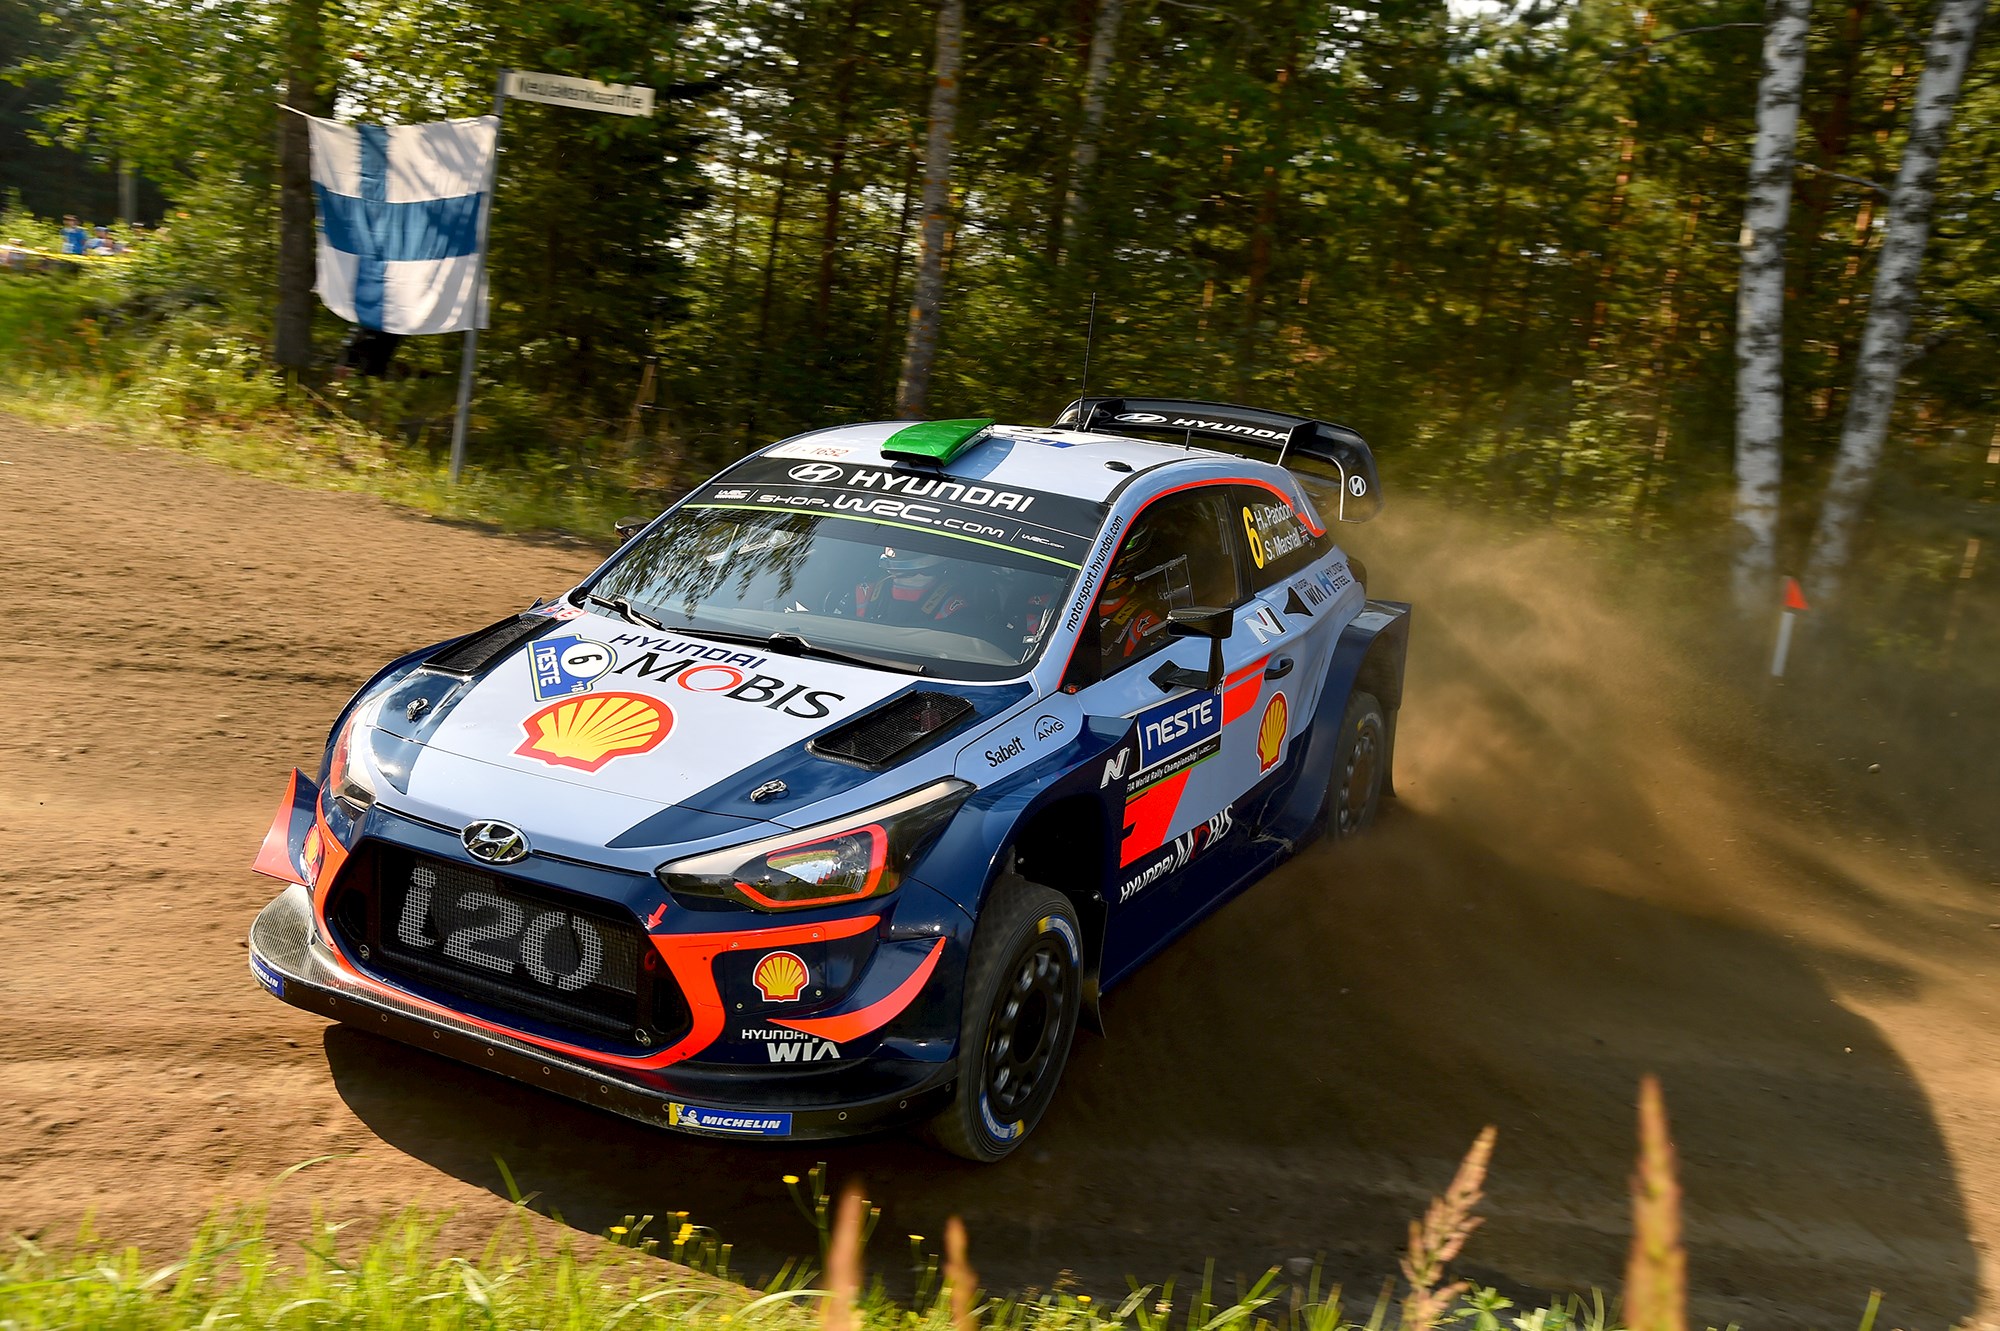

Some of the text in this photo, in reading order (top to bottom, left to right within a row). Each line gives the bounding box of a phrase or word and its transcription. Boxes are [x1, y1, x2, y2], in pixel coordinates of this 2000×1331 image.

[1172, 418, 1290, 441] HYUNDA
[847, 469, 1035, 513] HYUNDAI
[1264, 501, 1294, 526] Paddon
[1242, 506, 1264, 569] 6
[1066, 515, 1124, 633] motorsport.hyundai.com
[536, 646, 562, 687] NESTE
[567, 654, 603, 666] 6
[608, 633, 768, 669] HYUNDAI
[612, 652, 846, 719] MOBIS
[1145, 698, 1213, 751] NESTE
[984, 736, 1026, 768] Sabelt
[1135, 776, 1150, 788] World
[1150, 768, 1164, 781] Rally
[1164, 751, 1197, 774] Championship
[1169, 803, 1234, 875] MOBIS
[1119, 853, 1174, 904] HYUNDAI
[398, 866, 604, 992] i20
[766, 1038, 840, 1062] WIA
[701, 1114, 781, 1131] MICHELIN
